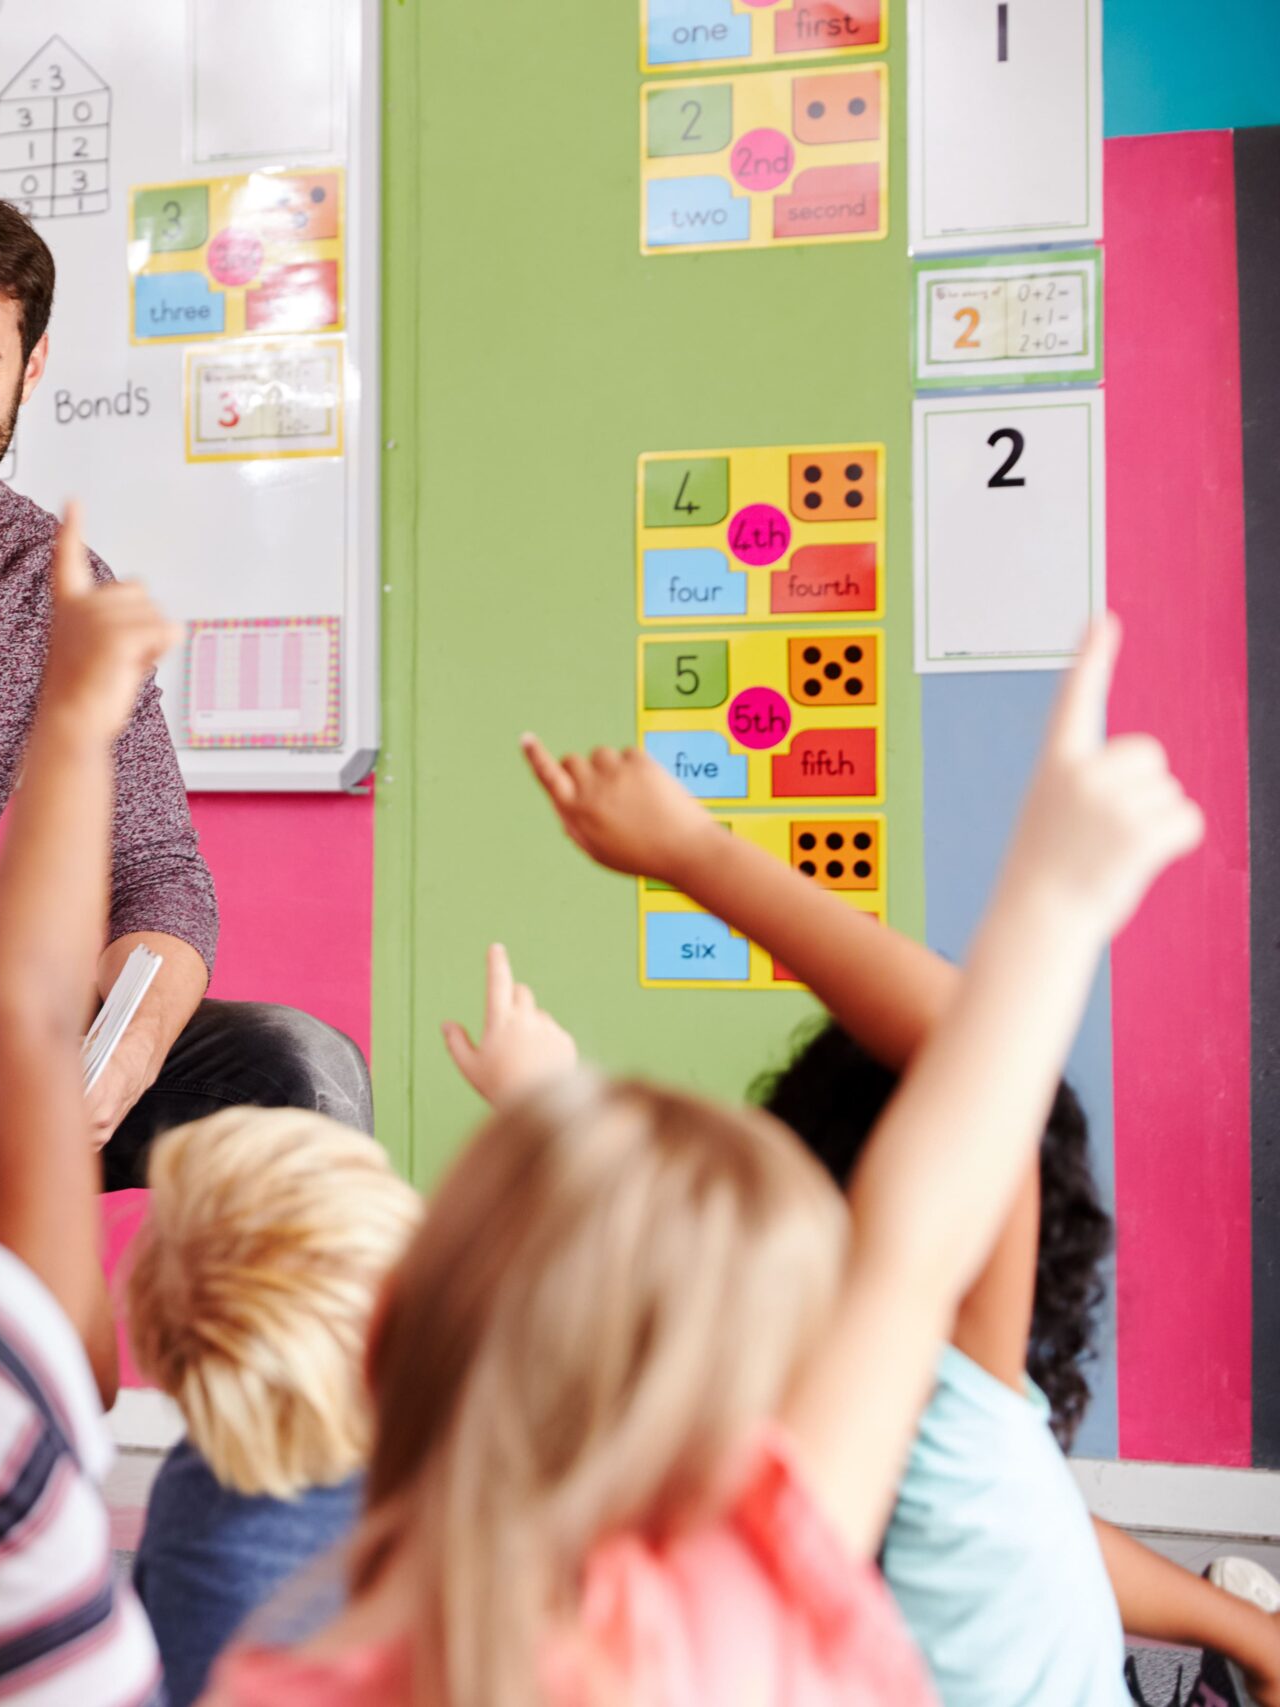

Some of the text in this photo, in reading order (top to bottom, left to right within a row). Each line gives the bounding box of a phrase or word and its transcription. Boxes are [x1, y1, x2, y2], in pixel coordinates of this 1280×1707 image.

[672, 22, 728, 44] one
[796, 9, 860, 39] first
[17, 100, 93, 128] 3 0
[681, 100, 702, 141] 2
[73, 136, 89, 158] 2
[737, 145, 790, 178] 2nd
[21, 169, 89, 195] 0 3
[162, 201, 183, 239] 3
[671, 207, 728, 229] two
[787, 195, 867, 222] second
[150, 299, 211, 323] three
[953, 306, 981, 349] 2
[54, 379, 150, 425] Bonds
[219, 392, 240, 428] 3
[987, 427, 1025, 488] 2
[673, 471, 701, 515] 4
[732, 519, 786, 551] 4th
[669, 576, 723, 603] four
[788, 574, 860, 598] fourth
[675, 655, 700, 696] 5
[733, 704, 786, 734] 5th
[675, 752, 719, 779] five
[801, 750, 855, 777] fifth
[681, 936, 716, 960] six
